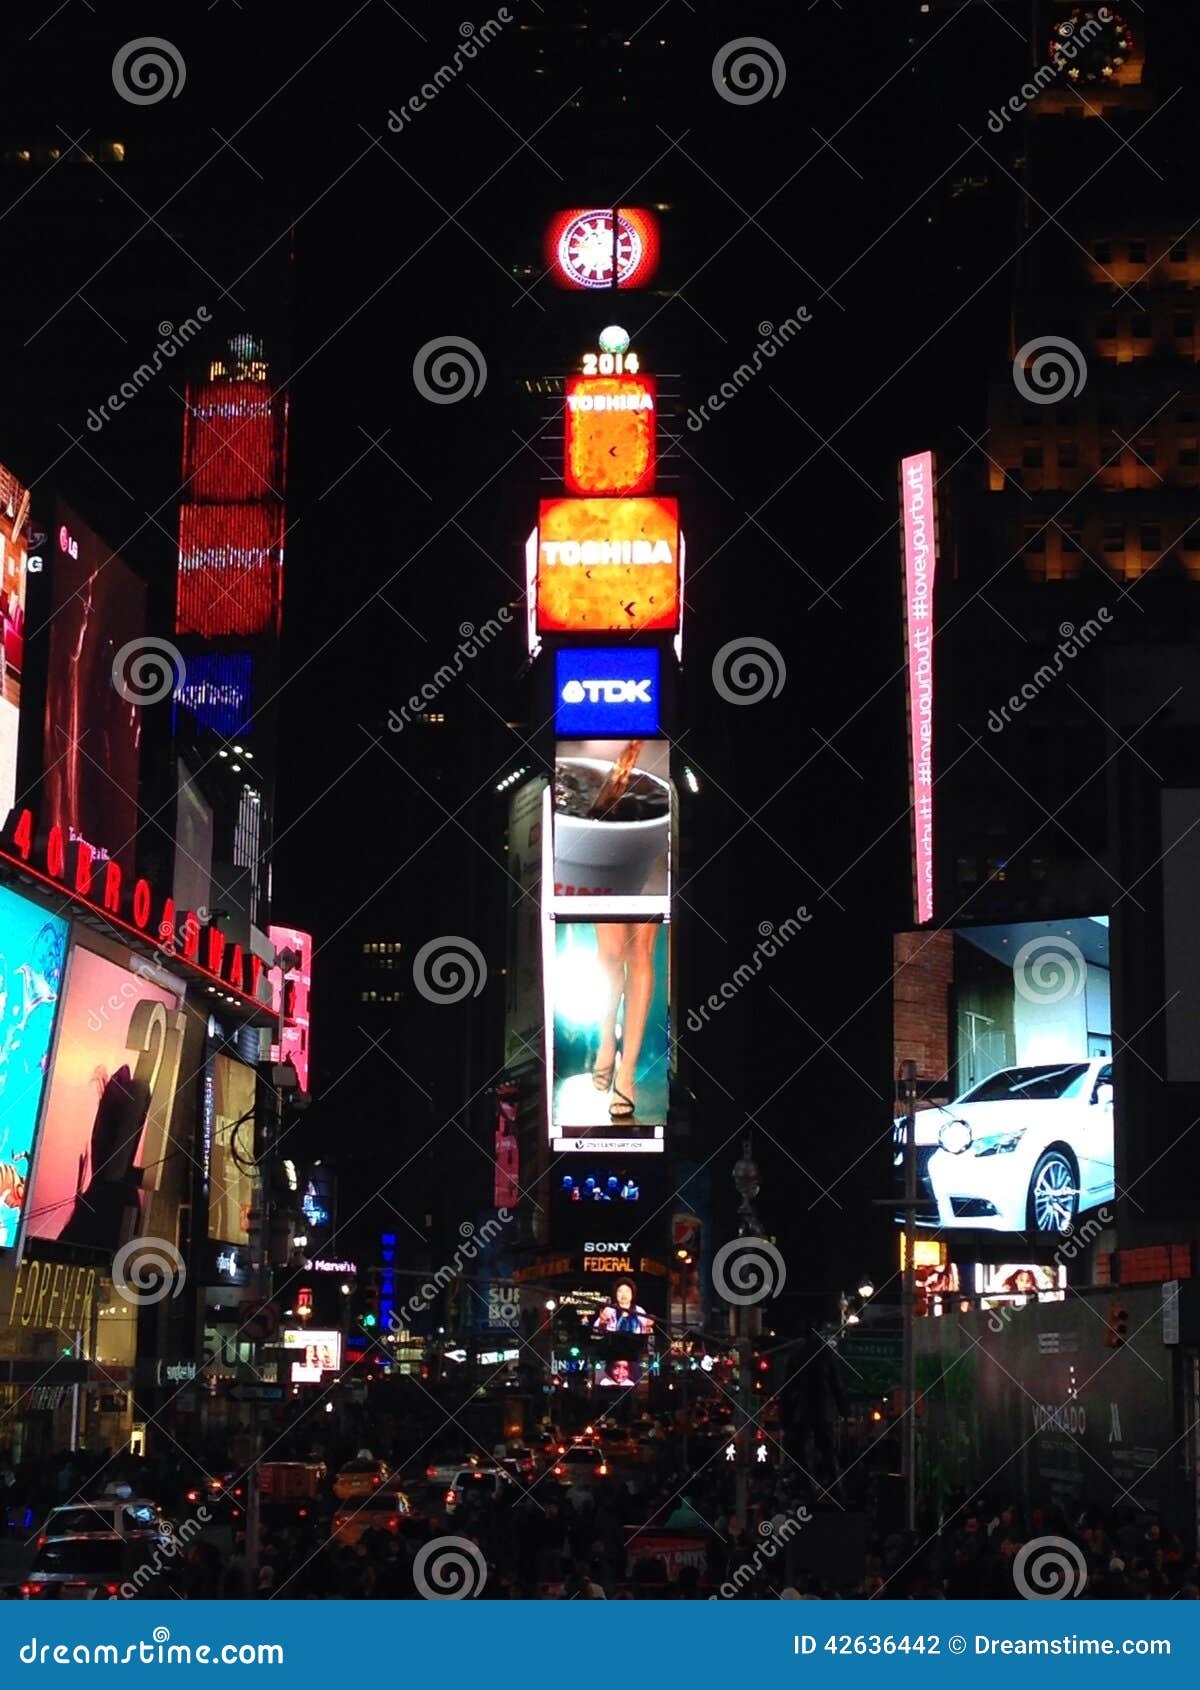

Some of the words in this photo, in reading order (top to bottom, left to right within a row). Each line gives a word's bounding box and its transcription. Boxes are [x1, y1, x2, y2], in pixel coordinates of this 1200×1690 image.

[582, 353, 639, 375] 2014
[567, 394, 653, 412] TOSHIBA
[907, 463, 930, 621] #loveyourbutt
[541, 540, 672, 567] TOSHIBA
[583, 680, 651, 703] TDK
[584, 1242, 632, 1252] SONY
[584, 1257, 634, 1272] FEDERAL
[9, 1258, 95, 1330] FOREVER
